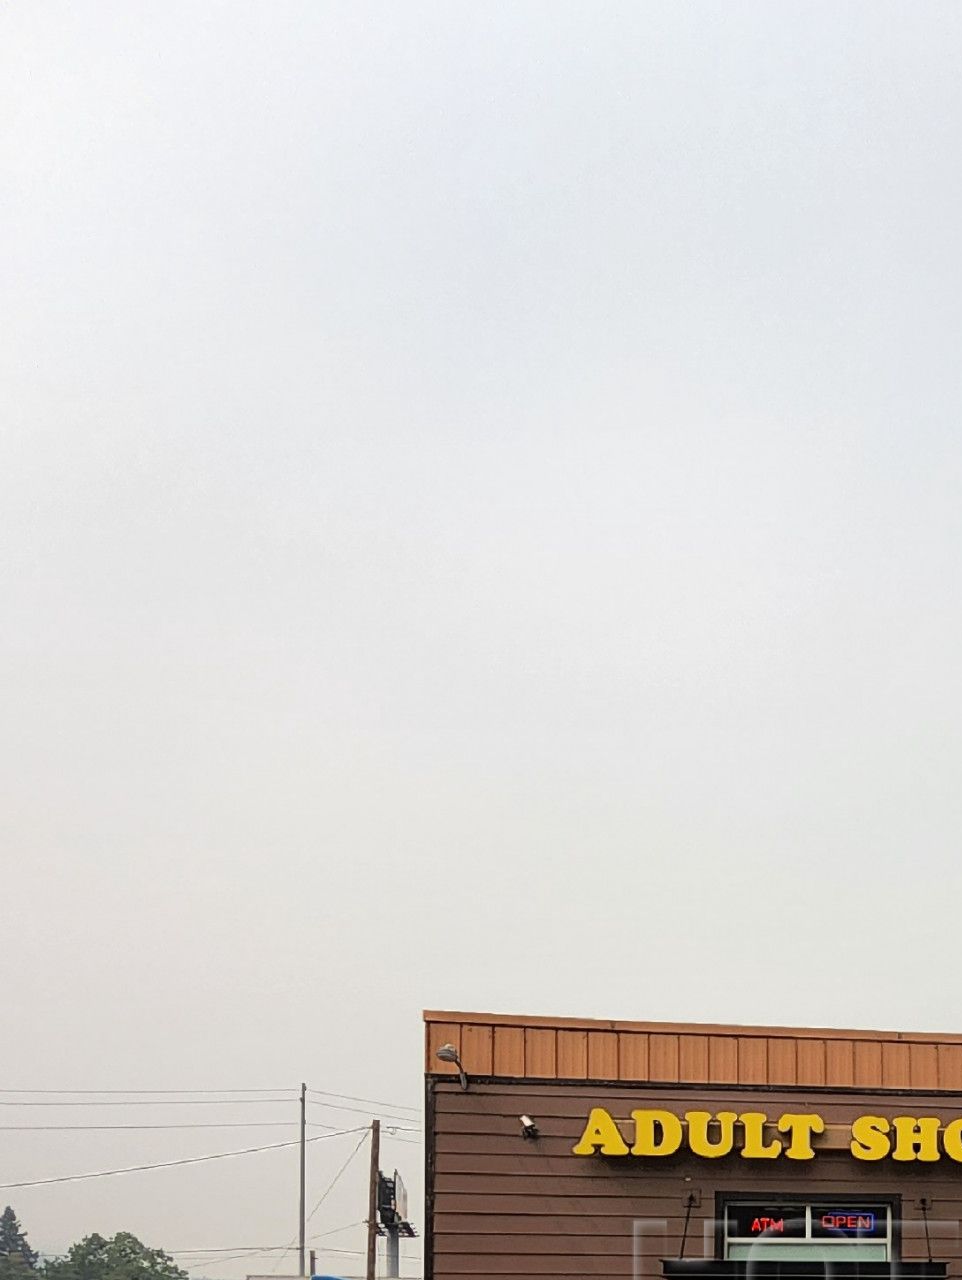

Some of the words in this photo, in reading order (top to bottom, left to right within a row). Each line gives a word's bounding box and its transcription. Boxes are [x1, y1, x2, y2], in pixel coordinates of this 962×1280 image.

[572, 1107, 825, 1160] ADULT
[751, 1217, 784, 1232] ATM
[821, 1215, 871, 1229] OPEN
